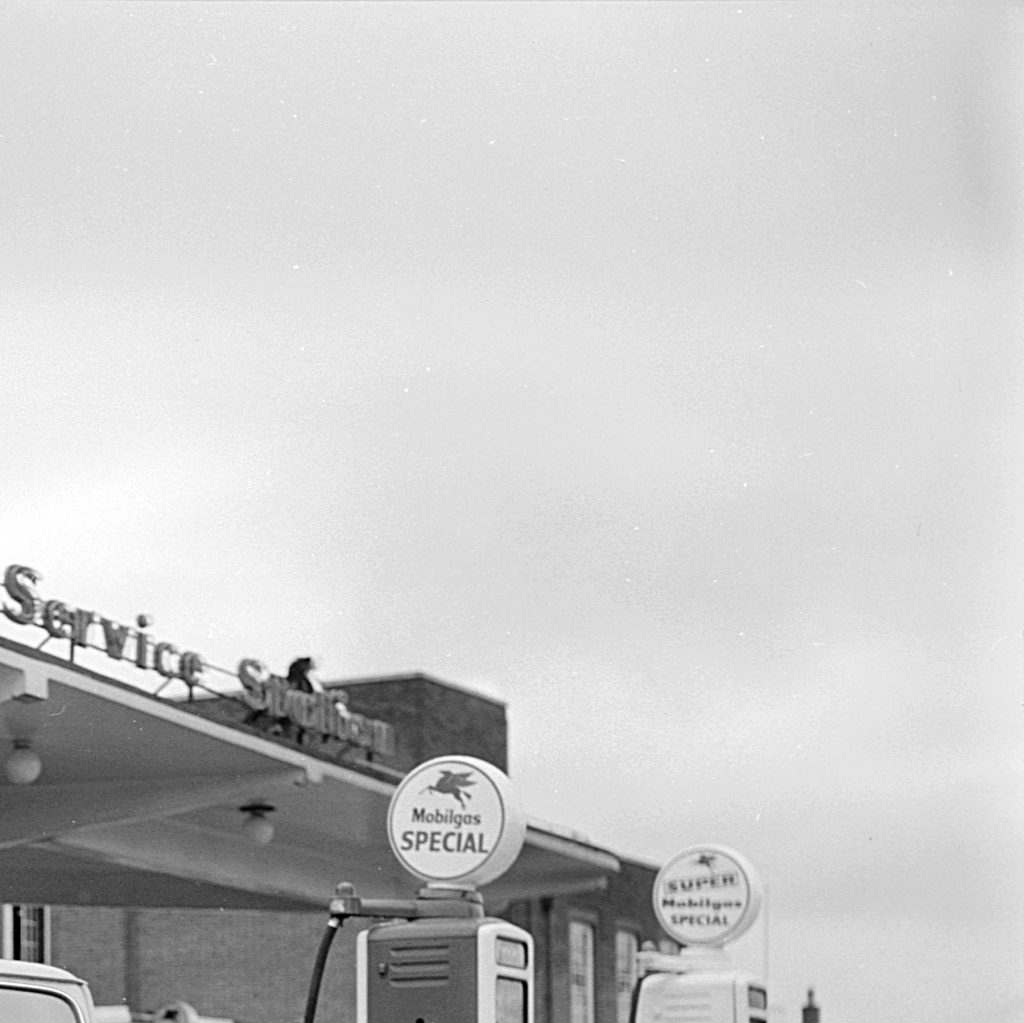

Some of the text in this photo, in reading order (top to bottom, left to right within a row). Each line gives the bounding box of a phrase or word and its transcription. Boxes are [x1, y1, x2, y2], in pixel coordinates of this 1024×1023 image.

[3, 564, 205, 685] Service
[412, 807, 482, 829] Mobilgas
[400, 830, 489, 853] SPECIAL
[668, 873, 735, 890] SUPER
[670, 914, 728, 925] SPECIAL
